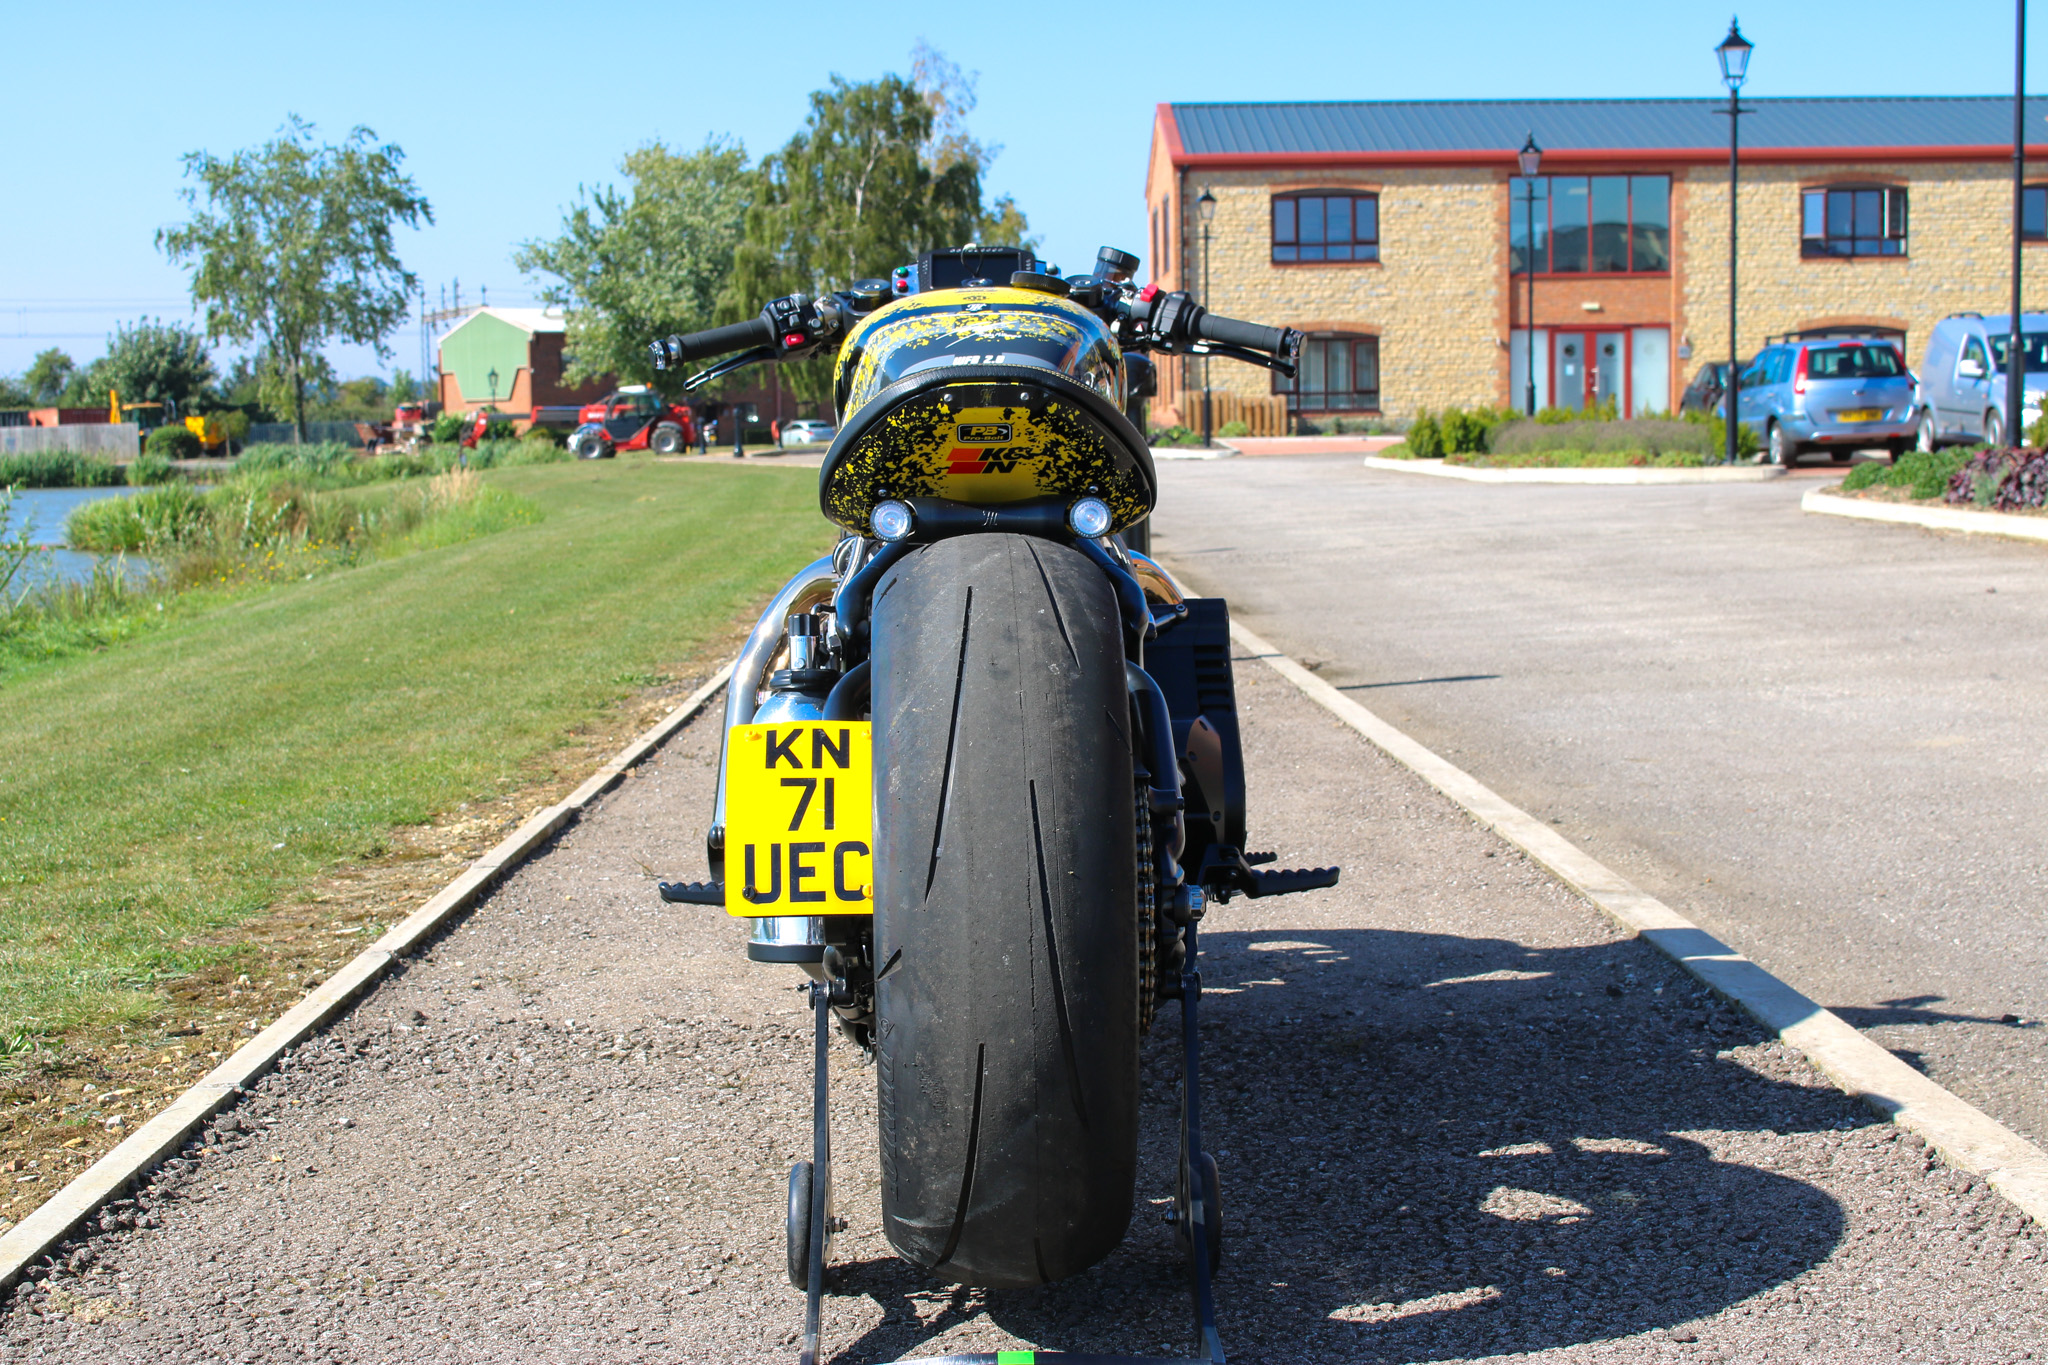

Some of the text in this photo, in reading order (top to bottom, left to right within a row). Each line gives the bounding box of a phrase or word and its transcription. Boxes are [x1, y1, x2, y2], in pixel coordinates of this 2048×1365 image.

[983, 354, 1005, 364] 2.0
[970, 426, 998, 435] PB
[765, 728, 850, 769] KN
[780, 778, 835, 831] 71
[744, 841, 870, 904] UEC
